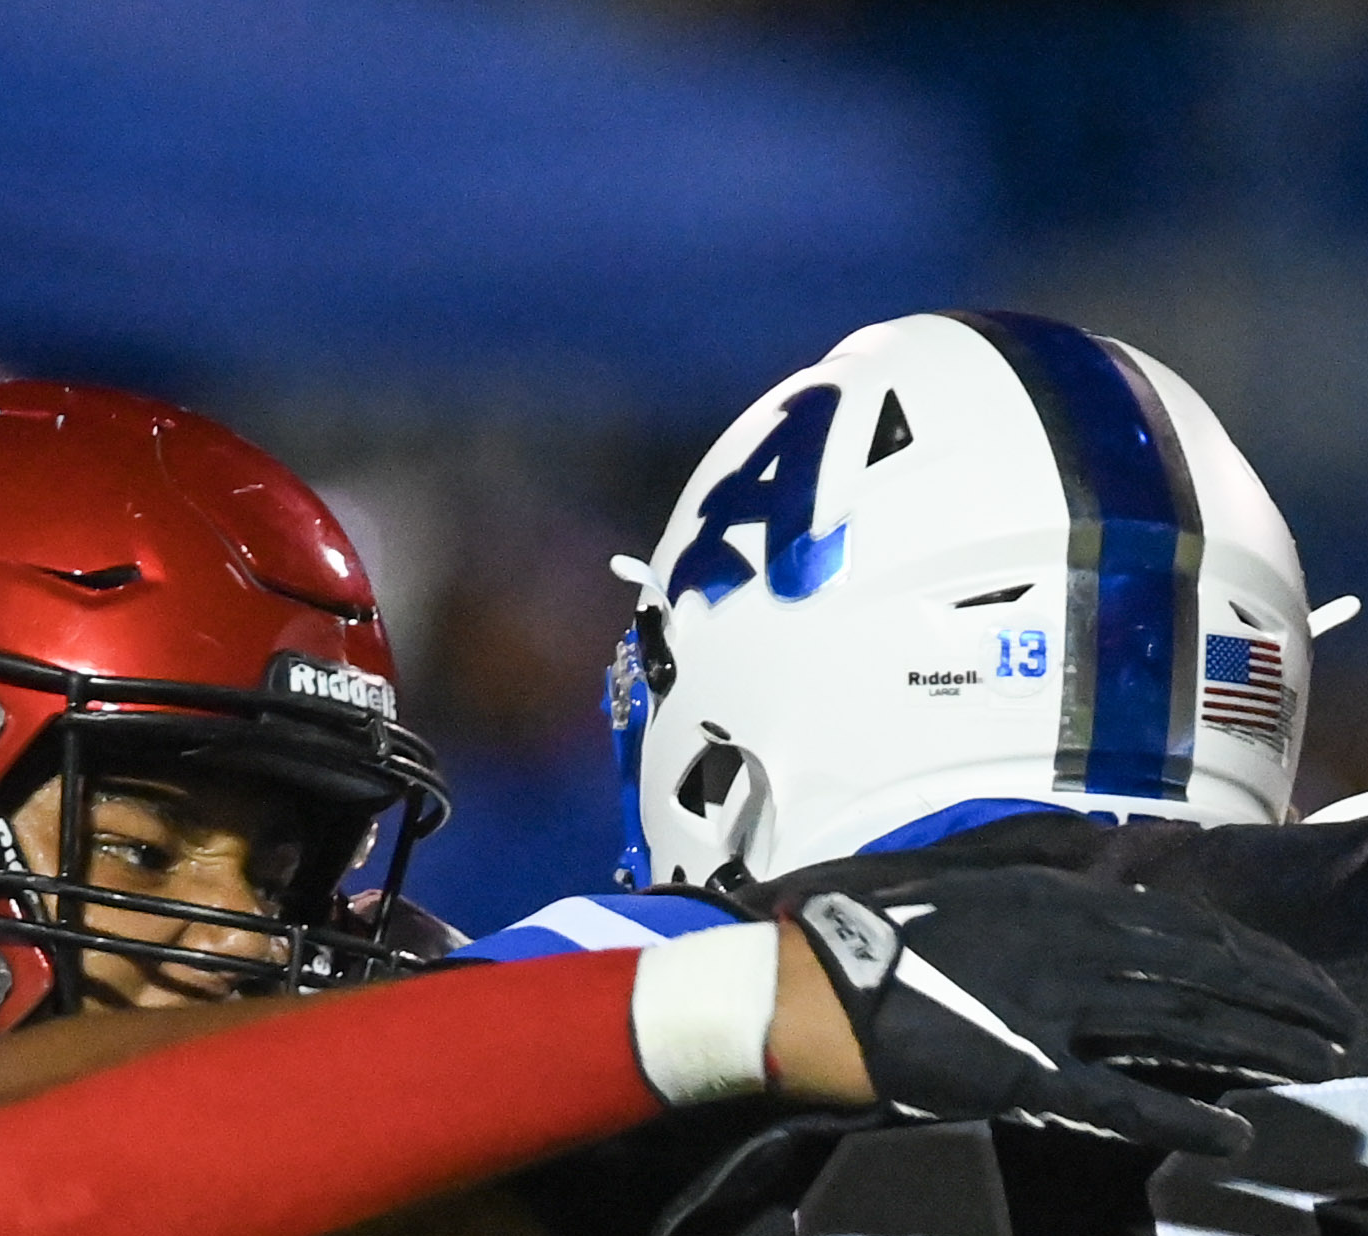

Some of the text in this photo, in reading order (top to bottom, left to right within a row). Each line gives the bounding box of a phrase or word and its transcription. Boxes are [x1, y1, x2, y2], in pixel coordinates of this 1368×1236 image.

[666, 383, 849, 609] A
[996, 629, 1048, 678] 13
[289, 663, 398, 721] Riddell
[908, 671, 979, 686] Riddell
[928, 687, 961, 697] LARGE
